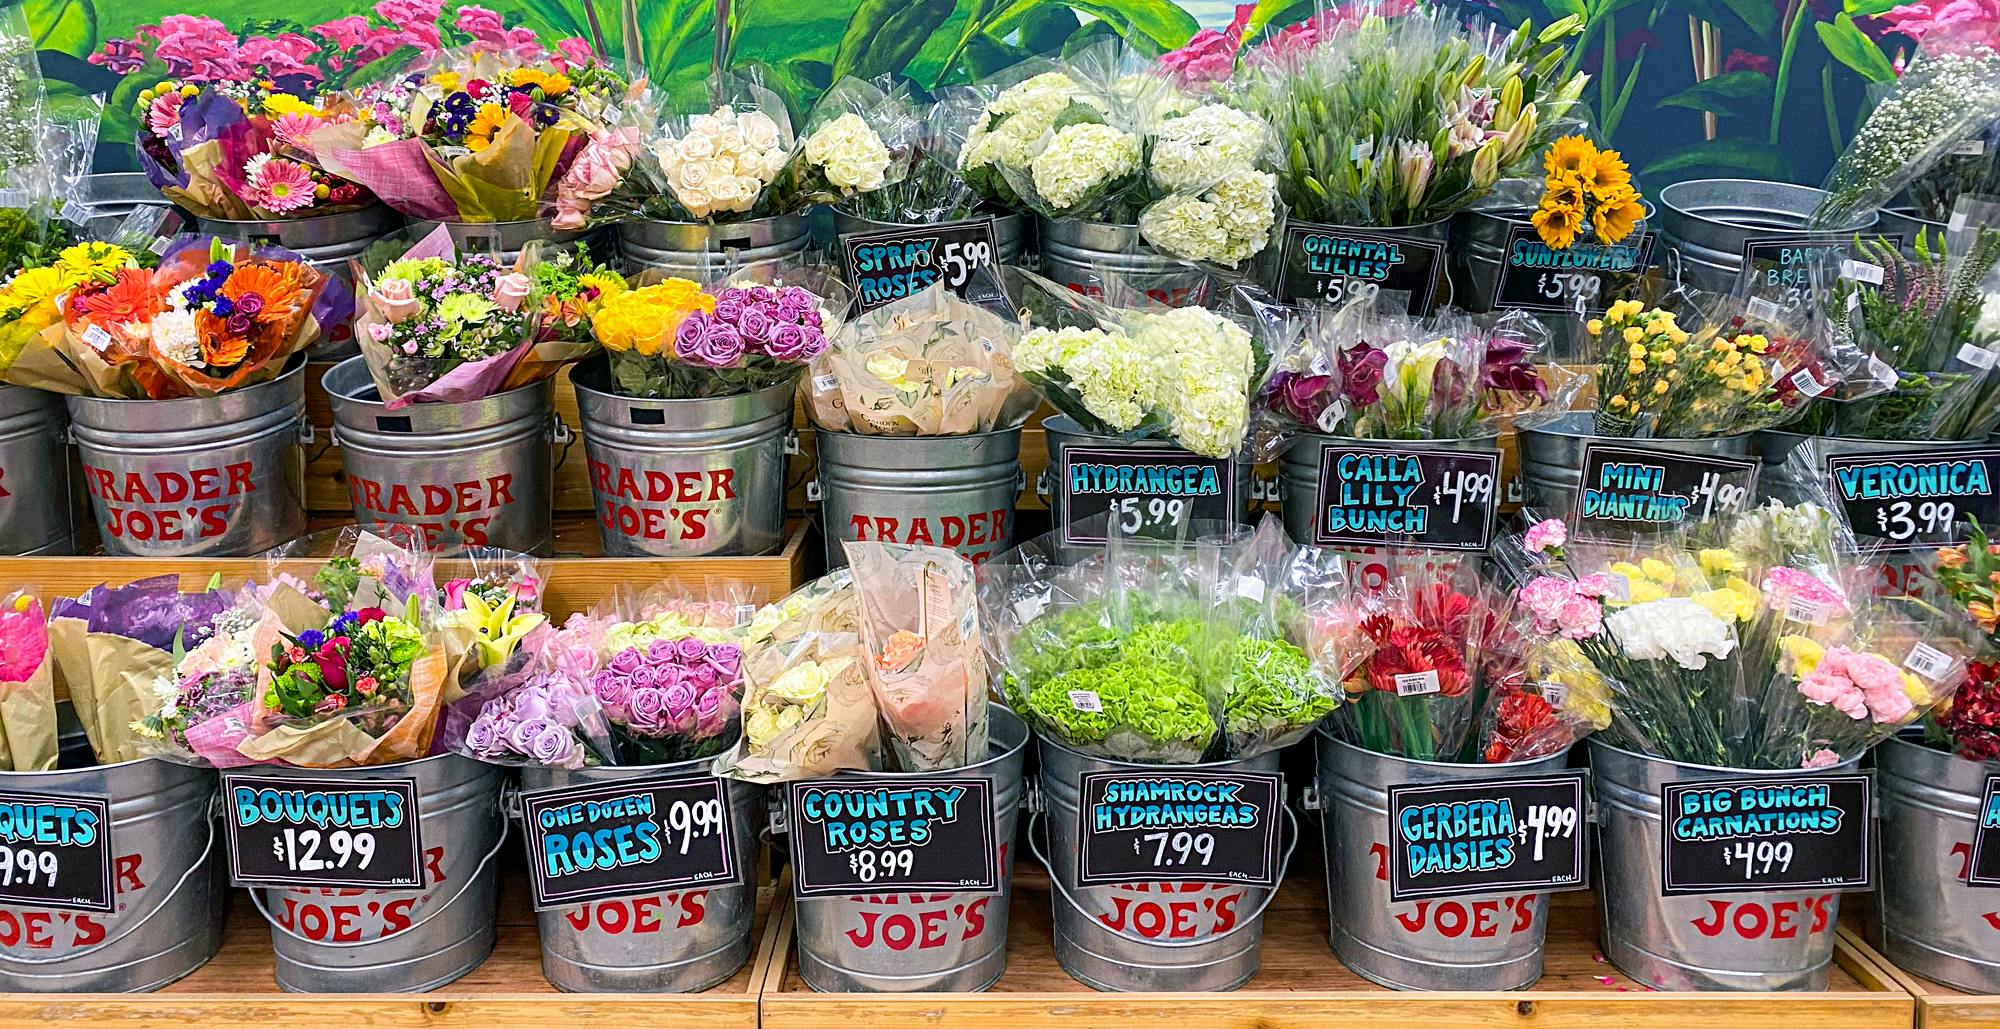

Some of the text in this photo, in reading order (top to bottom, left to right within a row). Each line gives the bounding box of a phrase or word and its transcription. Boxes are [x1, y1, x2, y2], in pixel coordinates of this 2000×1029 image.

[855, 239, 936, 272] SPRAY
[938, 240, 991, 287] $5.99
[1304, 235, 1403, 263] ORIENTAL
[1310, 254, 1389, 279] LILIES
[1511, 239, 1636, 272] SUNFLOWERS
[860, 269, 938, 304] ROSES
[83, 461, 256, 504] TRADER
[1070, 463, 1221, 496] HYDRANGEA
[1338, 453, 1425, 483] CALLA
[1601, 463, 1664, 491] MINI
[1835, 460, 1991, 500] VERONICA
[348, 473, 516, 516] TRADER
[1342, 482, 1416, 507] LILY
[1433, 470, 1492, 524] $4.99
[1583, 490, 1690, 522] DIANTHUS
[1691, 471, 1746, 524] $4.99
[106, 503, 230, 541] JOE'S
[600, 500, 711, 540] JOE'S
[850, 508, 1007, 548] TRADER
[1109, 497, 1184, 535] $5.99
[1329, 506, 1428, 533] BUNCH
[1876, 501, 1955, 540] $3.99
[234, 786, 404, 829] BOUQUETS
[803, 787, 966, 823] COUNTRY
[1104, 779, 1243, 804] SHAMROCK
[1681, 785, 1829, 816] BIG BUNCH
[0, 803, 98, 846] QUETS
[539, 794, 654, 829] ONE DOZEN
[664, 799, 723, 855] $9.99
[1093, 802, 1258, 832] HYDRANGEAS
[1400, 799, 1515, 841] GERBERA
[1674, 808, 1845, 841] CARNATIONS
[272, 828, 376, 871] $12.99
[543, 822, 661, 877] ROSES
[826, 819, 931, 851] ROSES
[1133, 832, 1215, 867] $7.99
[1518, 805, 1576, 861] $4.99
[693, 871, 713, 881] EACH
[849, 850, 914, 882] $8.99
[1408, 838, 1515, 878] DAISIES
[1723, 841, 1793, 880] $4.99
[1552, 874, 1572, 882] EACH
[72, 897, 92, 905] EACH
[276, 897, 417, 942] JOE'S
[566, 889, 709, 934] JOE'S
[1098, 893, 1241, 939] JOE'S
[1395, 894, 1536, 938] JOE'S
[1690, 893, 1836, 939] JOE'S
[845, 896, 990, 951] JOE'S
